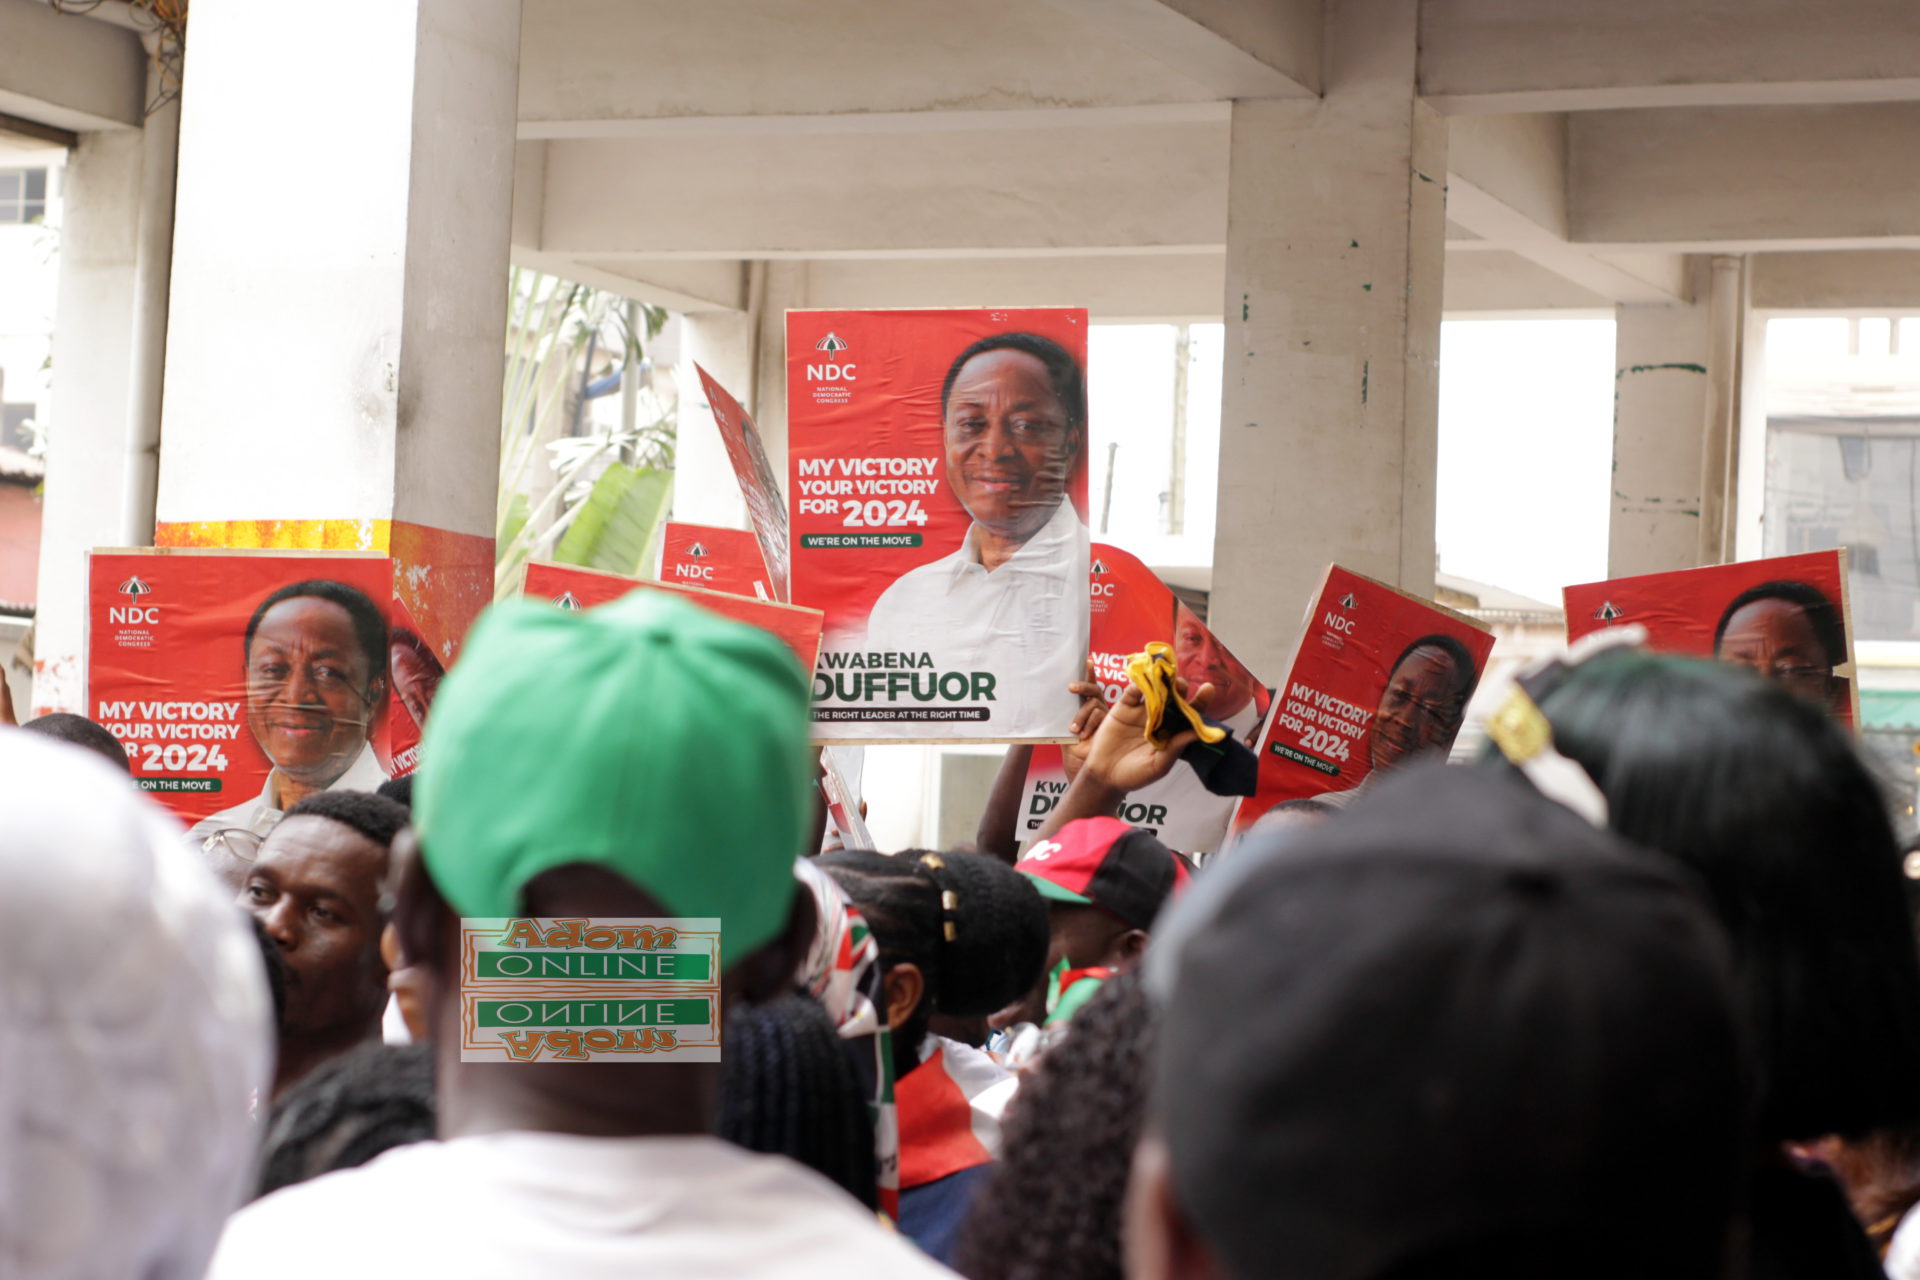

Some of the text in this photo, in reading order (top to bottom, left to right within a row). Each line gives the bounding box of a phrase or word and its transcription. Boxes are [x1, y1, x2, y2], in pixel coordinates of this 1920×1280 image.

[807, 364, 857, 381] NDC
[798, 457, 939, 477] MY VICTORY
[798, 479, 939, 495] YOUR VICTORY
[799, 499, 928, 527] FOR 2024
[807, 536, 912, 546] WE'RE ON THE MOVE
[676, 563, 714, 580] NDC
[1090, 583, 1115, 596] DC
[109, 607, 160, 624] NDC
[1324, 611, 1356, 635] NDC
[813, 672, 997, 701] DUFFUOR
[99, 701, 240, 720] MY VICTORY
[1291, 682, 1372, 725] MY VICTORY
[813, 711, 830, 720] THE
[832, 711, 859, 719] RIGHT
[861, 711, 896, 719] LEADER
[897, 711, 909, 719] AT
[911, 711, 928, 719] THE
[930, 711, 957, 719] RIGHT
[1286, 699, 1366, 740] YOUR VICTORY
[156, 723, 240, 739] VICTORY
[1279, 713, 1349, 762] FOR 2024
[142, 743, 228, 771] 2024
[1293, 752, 1305, 762] ON
[1304, 756, 1317, 767] THE
[1316, 761, 1335, 774] MOVE
[141, 781, 157, 790] ON
[159, 781, 179, 790] THE
[181, 781, 211, 790] MOVE
